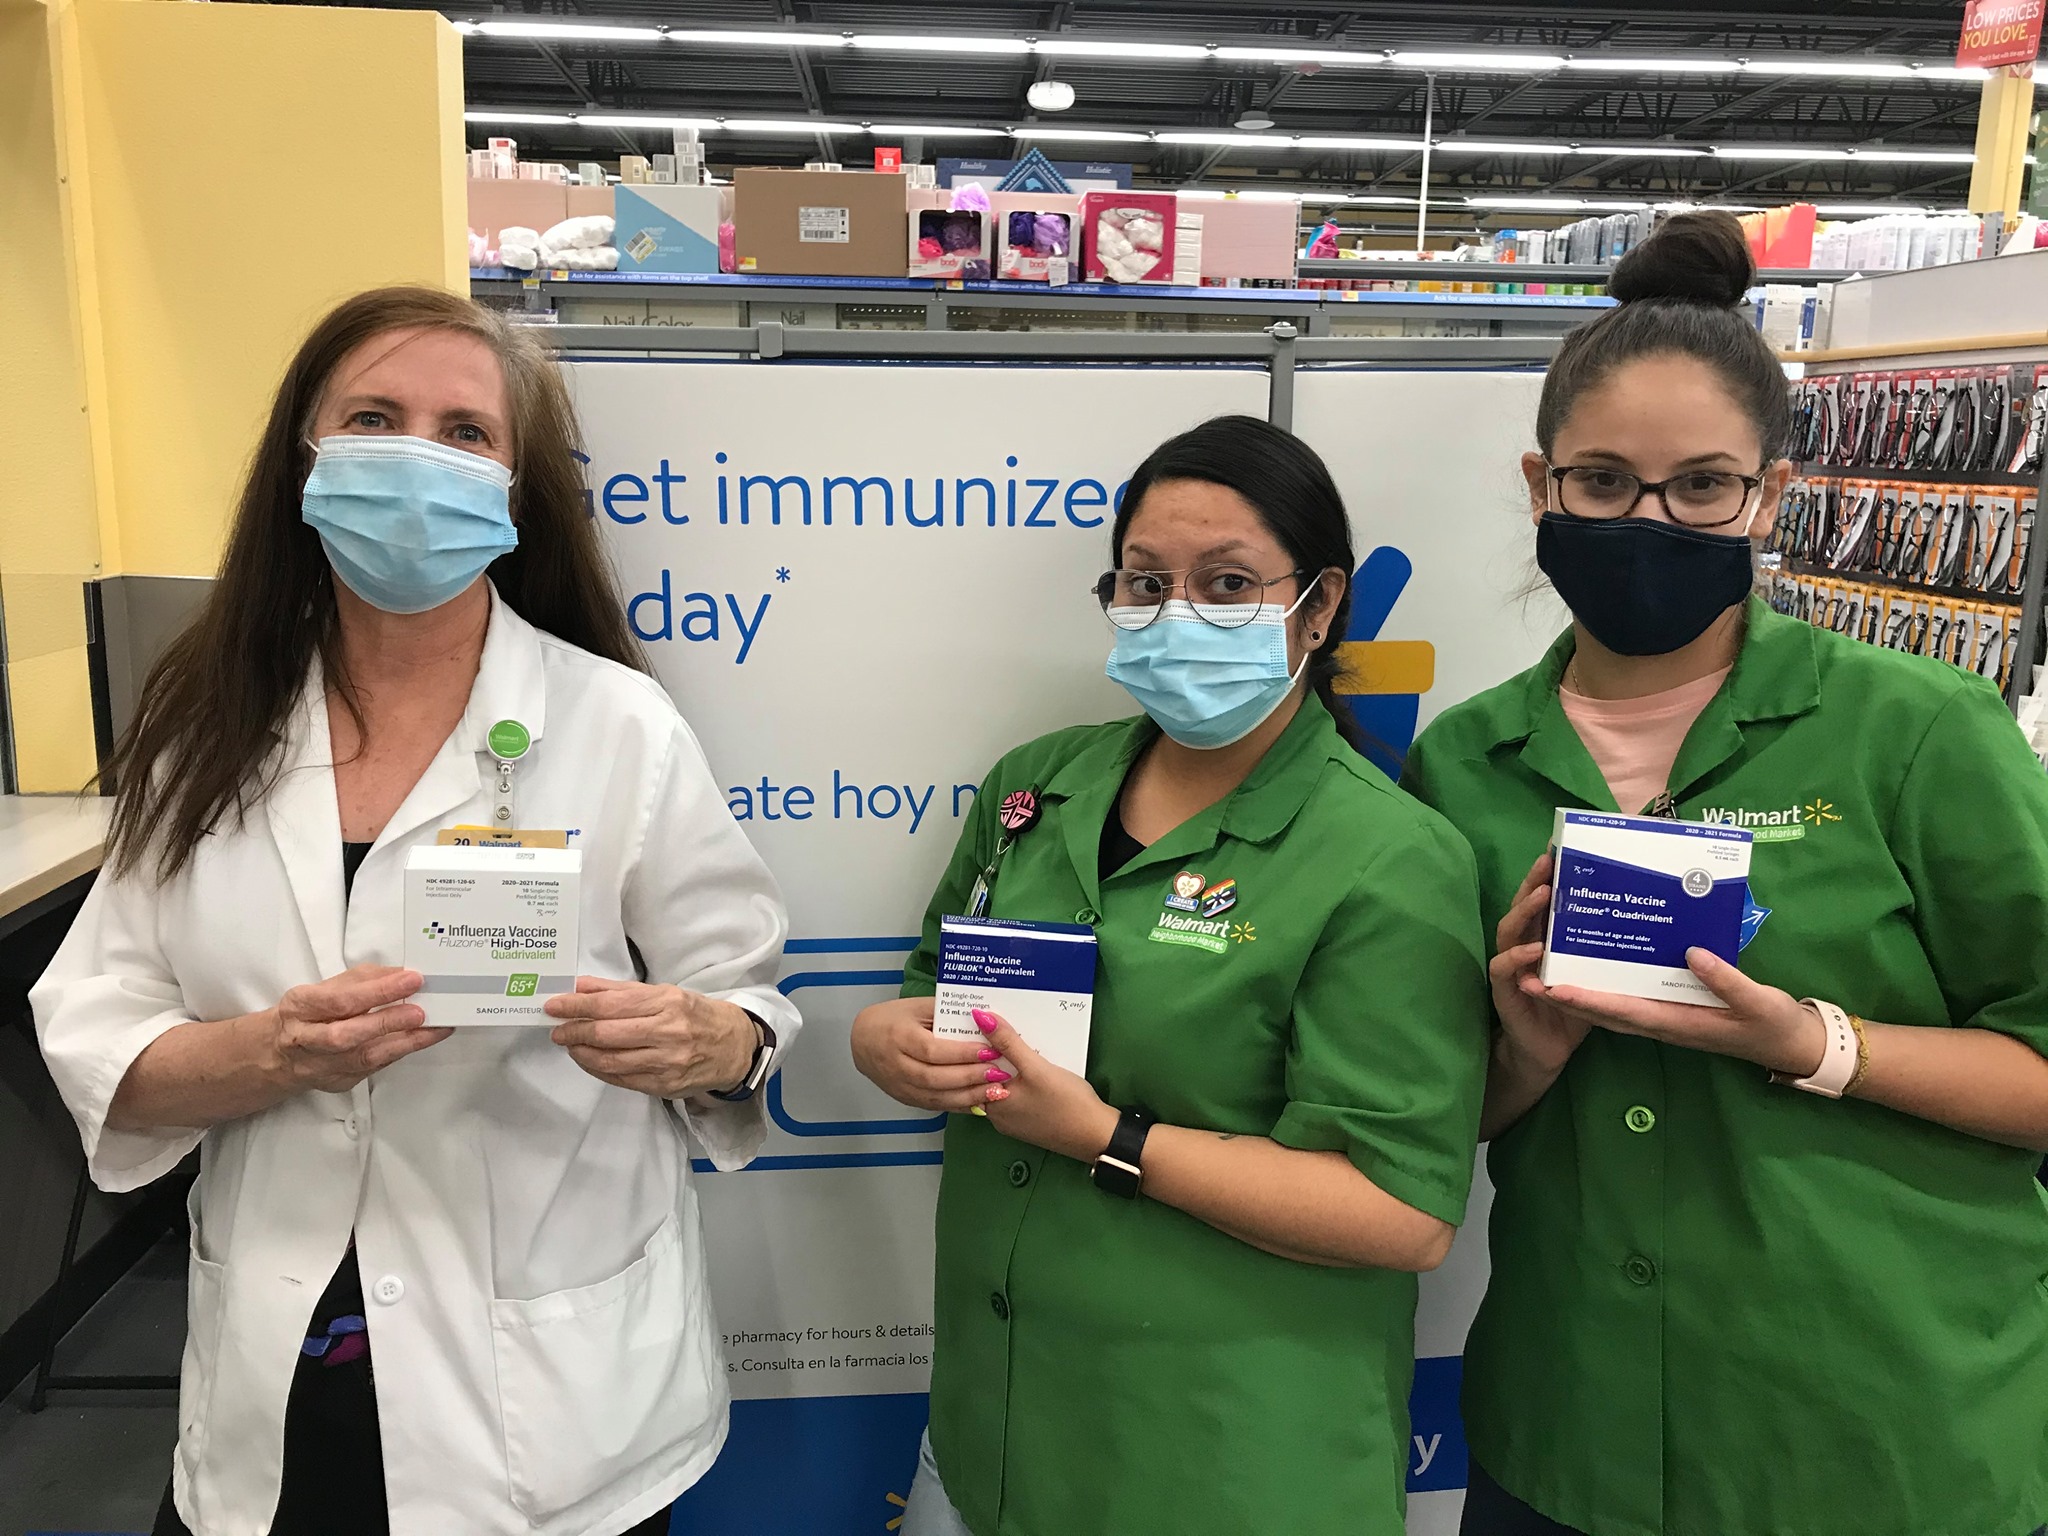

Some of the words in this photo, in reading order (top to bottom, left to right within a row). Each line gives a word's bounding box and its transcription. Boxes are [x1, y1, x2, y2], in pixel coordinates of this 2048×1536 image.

[1966, 9, 1996, 30] LOW
[1997, 2, 2040, 25] PRICES
[1964, 29, 1991, 49] YOU
[1994, 23, 2028, 45] LOVE.
[960, 162, 987, 171] Healthy
[1085, 165, 1112, 175] Holistic
[940, 258, 958, 267] body
[1029, 259, 1047, 269] body
[603, 315, 635, 326] Nail
[781, 311, 805, 326] Nail
[715, 451, 1131, 528] immunize
[728, 776, 815, 821] ate
[833, 770, 935, 834] hoy
[1702, 805, 1801, 826] Walmart
[1718, 831, 1741, 839] Formula
[1769, 827, 1801, 839] Market
[479, 840, 522, 848] Walmart
[1582, 867, 1595, 875] only
[1693, 873, 1701, 883] 4
[1569, 887, 1620, 902] Influenza
[1624, 893, 1666, 907] Vaccine
[1612, 909, 1673, 924] Quadrivalent
[449, 925, 506, 937] Influenza
[509, 926, 557, 937] Vaccine
[1158, 912, 1230, 938] Walmart
[1566, 926, 1577, 934] For
[1582, 929, 1604, 937] months
[1612, 932, 1622, 940] age
[1623, 933, 1635, 941] and
[491, 938, 557, 950] High-Dose
[1151, 930, 1198, 944] Neighborhood
[1196, 935, 1225, 951] Market
[1576, 937, 1616, 947] intramuscular
[1616, 941, 1642, 950] injection
[1642, 944, 1656, 953] only
[491, 949, 556, 960] Quadrivalent
[945, 952, 985, 963] Influenza
[988, 955, 1021, 966] Vaccine
[984, 965, 1035, 976] Quadrivalent
[510, 980, 534, 993] 65+
[1661, 980, 1686, 988] SANOFI
[1687, 983, 1711, 992] PASTEU
[950, 992, 984, 1000] Single-Dose
[966, 1001, 990, 1009] Syringes
[1070, 1001, 1086, 1011] only
[732, 1330, 802, 1347] pharmacy
[806, 1328, 828, 1341] for
[832, 1327, 871, 1340] hours
[875, 1325, 886, 1338] &
[890, 1323, 934, 1337] details
[741, 1358, 805, 1372] Consulta
[808, 1359, 826, 1369] en
[829, 1356, 841, 1368] la
[845, 1353, 905, 1368] farmacia
[909, 1352, 929, 1365] los
